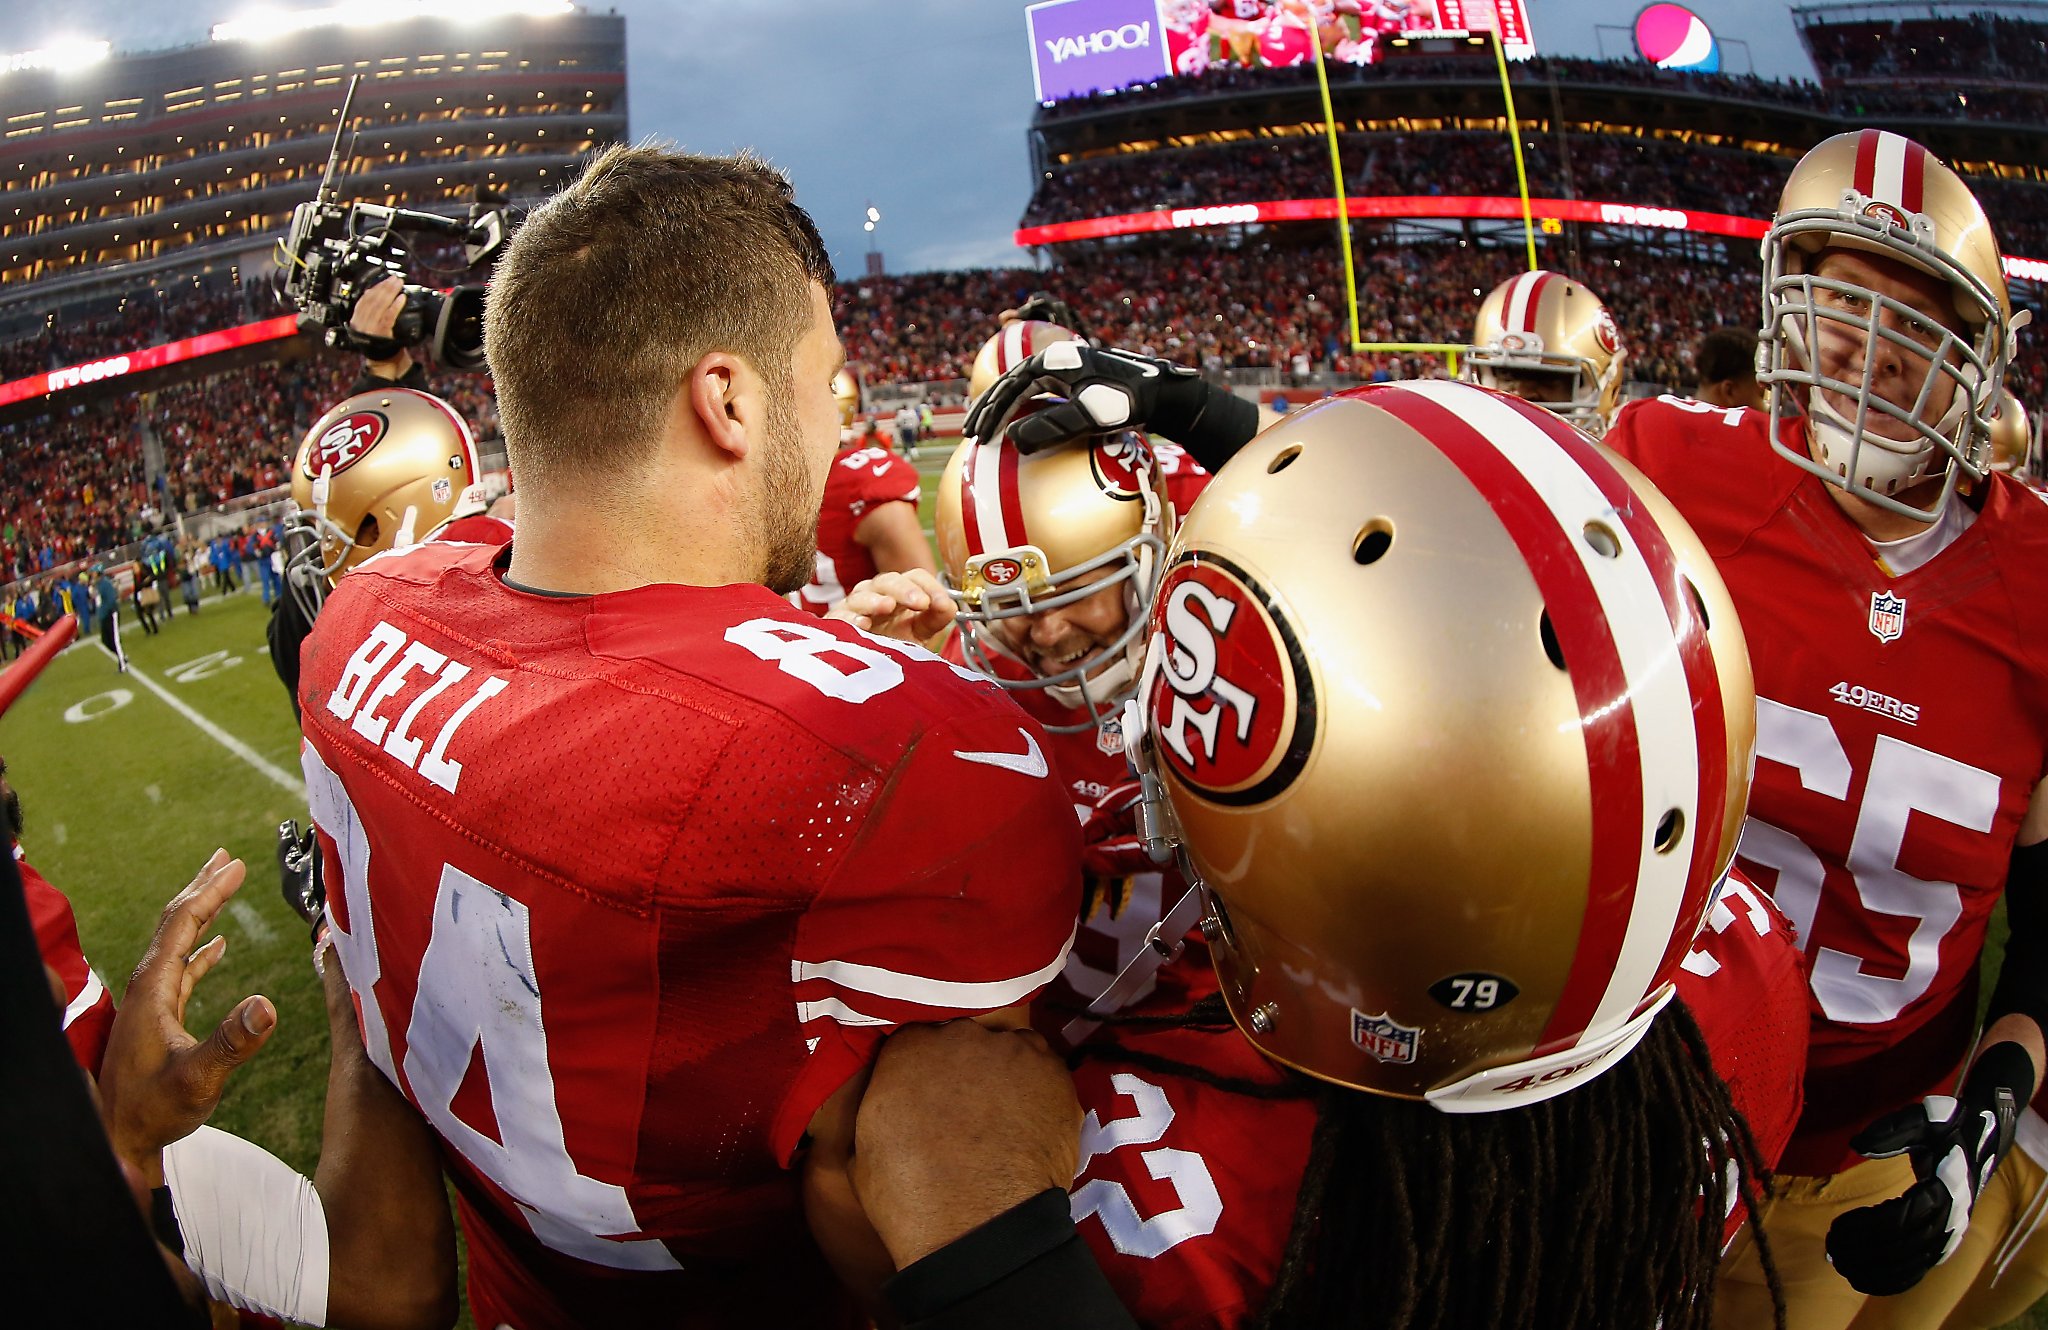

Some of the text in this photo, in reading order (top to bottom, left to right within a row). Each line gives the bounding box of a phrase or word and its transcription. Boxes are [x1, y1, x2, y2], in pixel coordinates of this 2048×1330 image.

[1044, 20, 1150, 64] YAHOO!
[988, 562, 1016, 583] SF
[1873, 610, 1899, 634] NFL
[1161, 580, 1257, 768] SF
[326, 620, 511, 796] BELL
[1828, 681, 1922, 727] 49ERS
[1450, 979, 1500, 1009] 79
[1358, 1031, 1407, 1062] NFL
